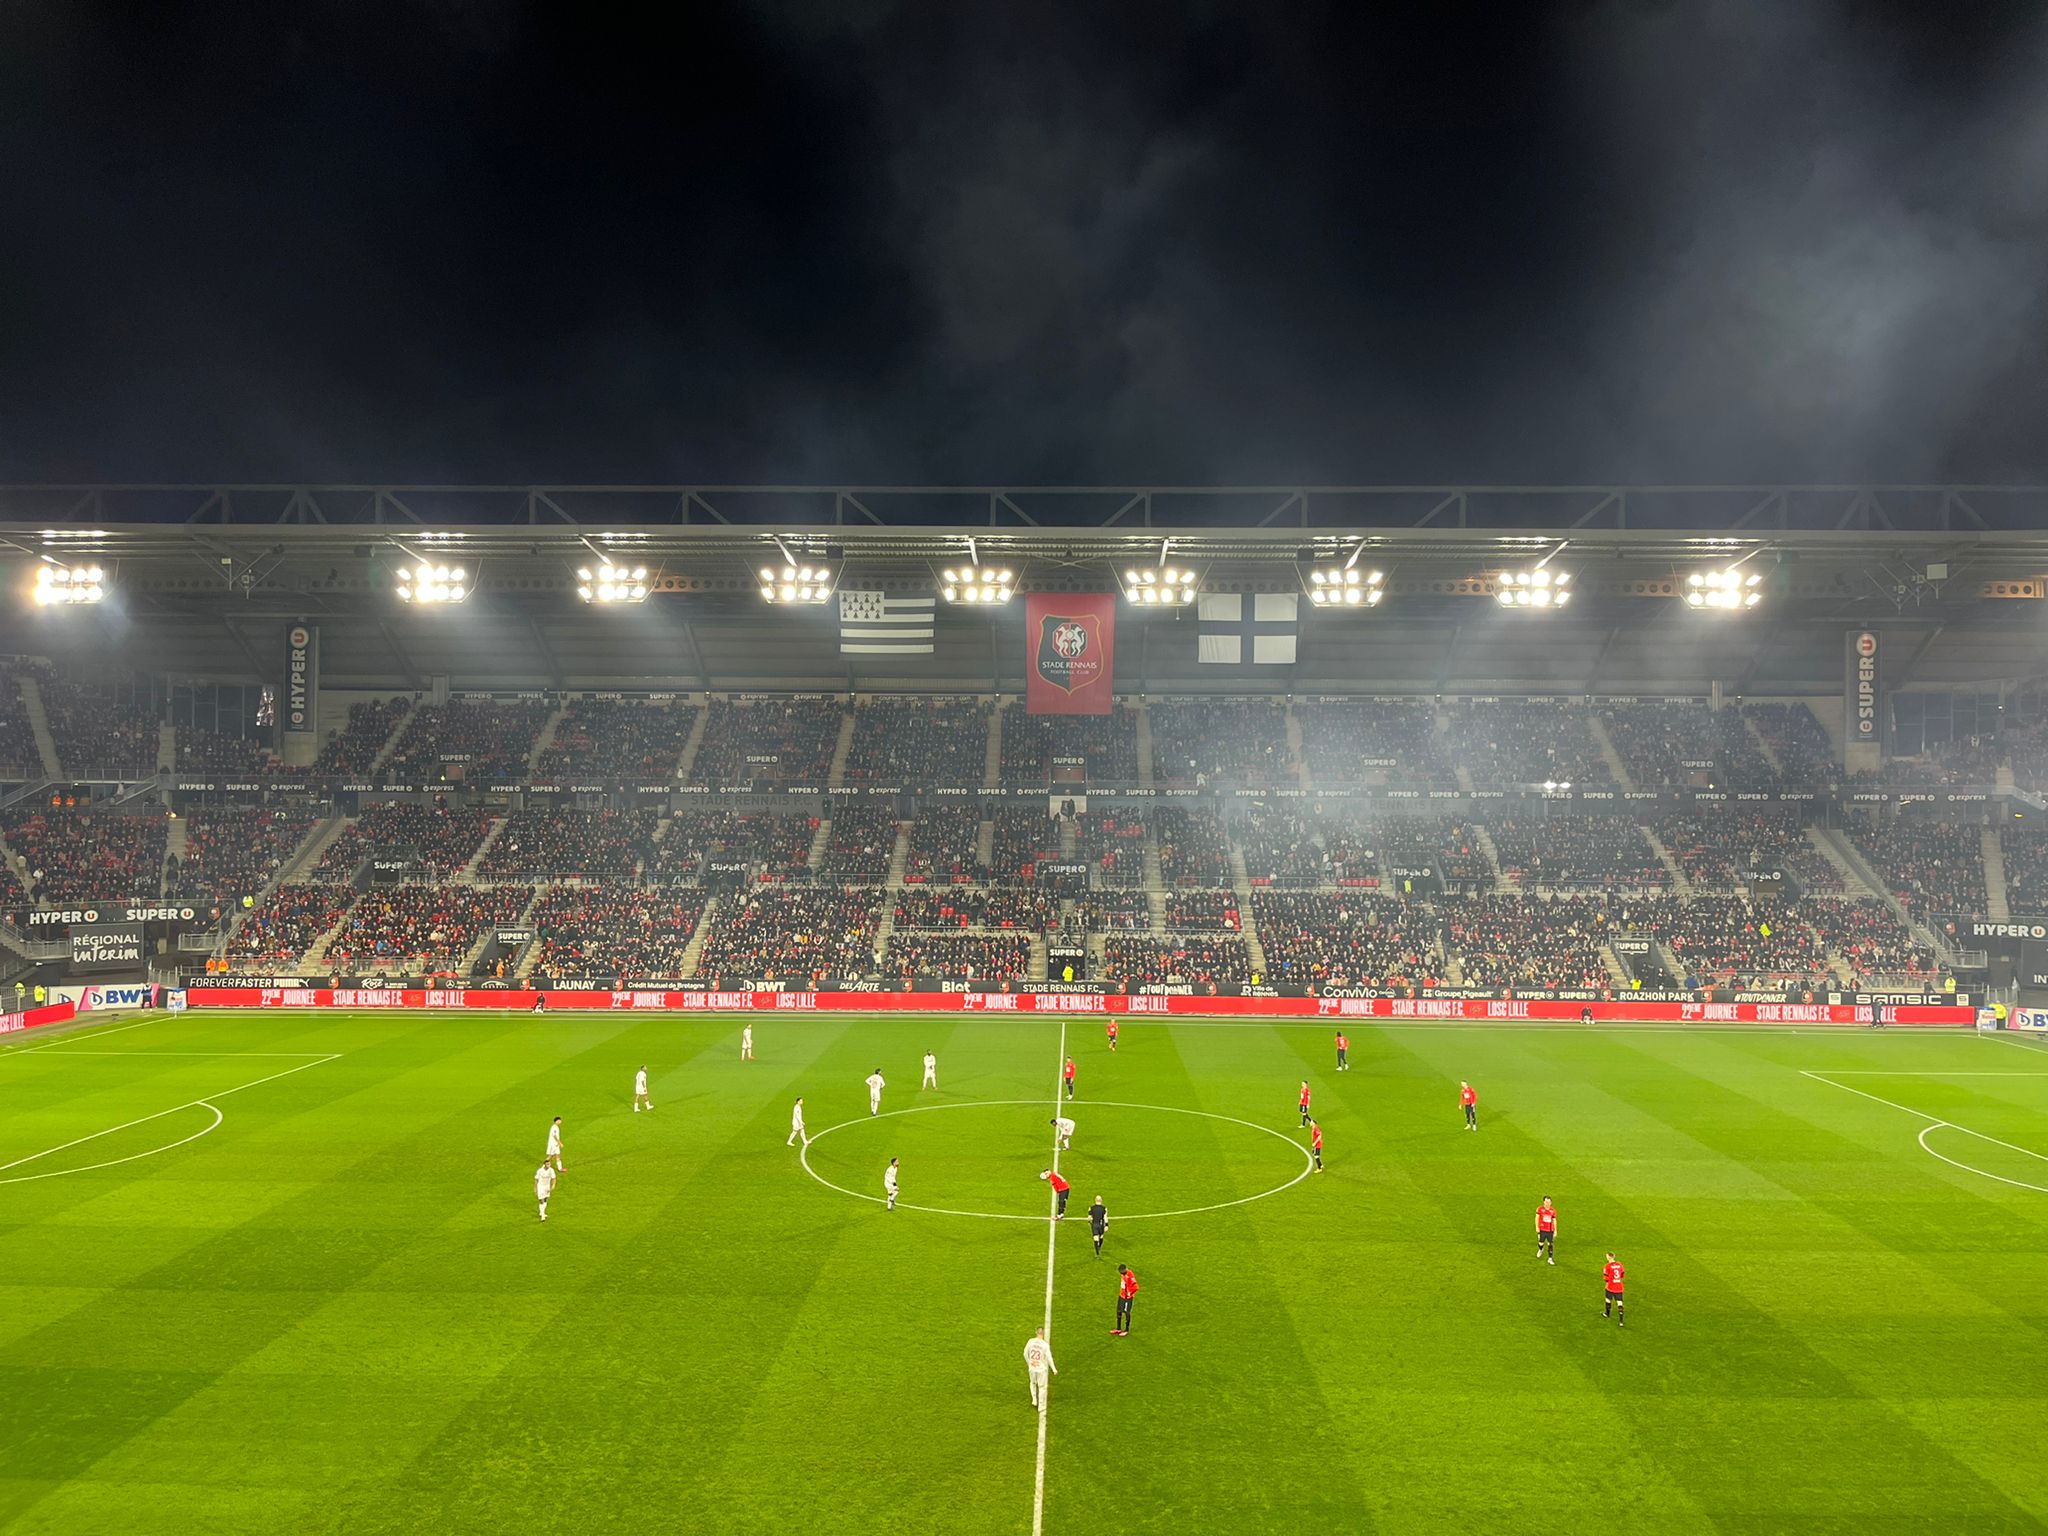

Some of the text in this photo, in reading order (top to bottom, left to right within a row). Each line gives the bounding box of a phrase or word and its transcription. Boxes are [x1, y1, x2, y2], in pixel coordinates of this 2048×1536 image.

[1042, 661, 1097, 669] STADE RENNAIS
[291, 649, 305, 709] HYPER
[1858, 657, 1874, 718] SUPER
[1048, 865, 1078, 873] SUPER
[30, 910, 82, 925] HYPER
[126, 908, 178, 921] SUPER
[1974, 924, 2029, 937] HYPER
[73, 933, 139, 946] RÉGIONAL
[553, 980, 596, 990] LAUNAY
[2034, 974, 2048, 984] IN
[756, 981, 786, 992] BWT
[1023, 984, 1048, 992] STADE
[1050, 984, 1085, 993] RENNAIS
[106, 990, 142, 1004] BW
[333, 990, 355, 1006] STADE
[357, 990, 391, 1006] RENNAIS
[425, 991, 444, 1006] LOSC
[445, 991, 466, 1006] LILLE
[683, 992, 706, 1008] STADE
[707, 992, 741, 1008] RENNAIS
[776, 993, 796, 1008] LOSC
[797, 993, 817, 1008] LILLE
[1035, 994, 1058, 1010] STADE
[1059, 994, 1093, 1010] RENNAIS
[1516, 991, 1588, 1000] HYPER SUPER
[1619, 991, 1694, 1002] ROAZHON PARK
[1855, 994, 1942, 1005] SAMSIC
[1128, 996, 1148, 1012] LOSC
[1148, 996, 1169, 1012] LILLE
[1391, 1000, 1415, 1016] STADE
[1416, 1001, 1451, 1016] RENNAIS
[1487, 1001, 1508, 1017] LOSC
[1508, 1001, 1529, 1017] LILLE
[1756, 1005, 1781, 1021] STADE
[1781, 1005, 1817, 1021] RENNAIS
[9, 1012, 25, 1031] LILLE
[1613, 1270, 1620, 1279] 3
[1030, 1350, 1041, 1361] 23
